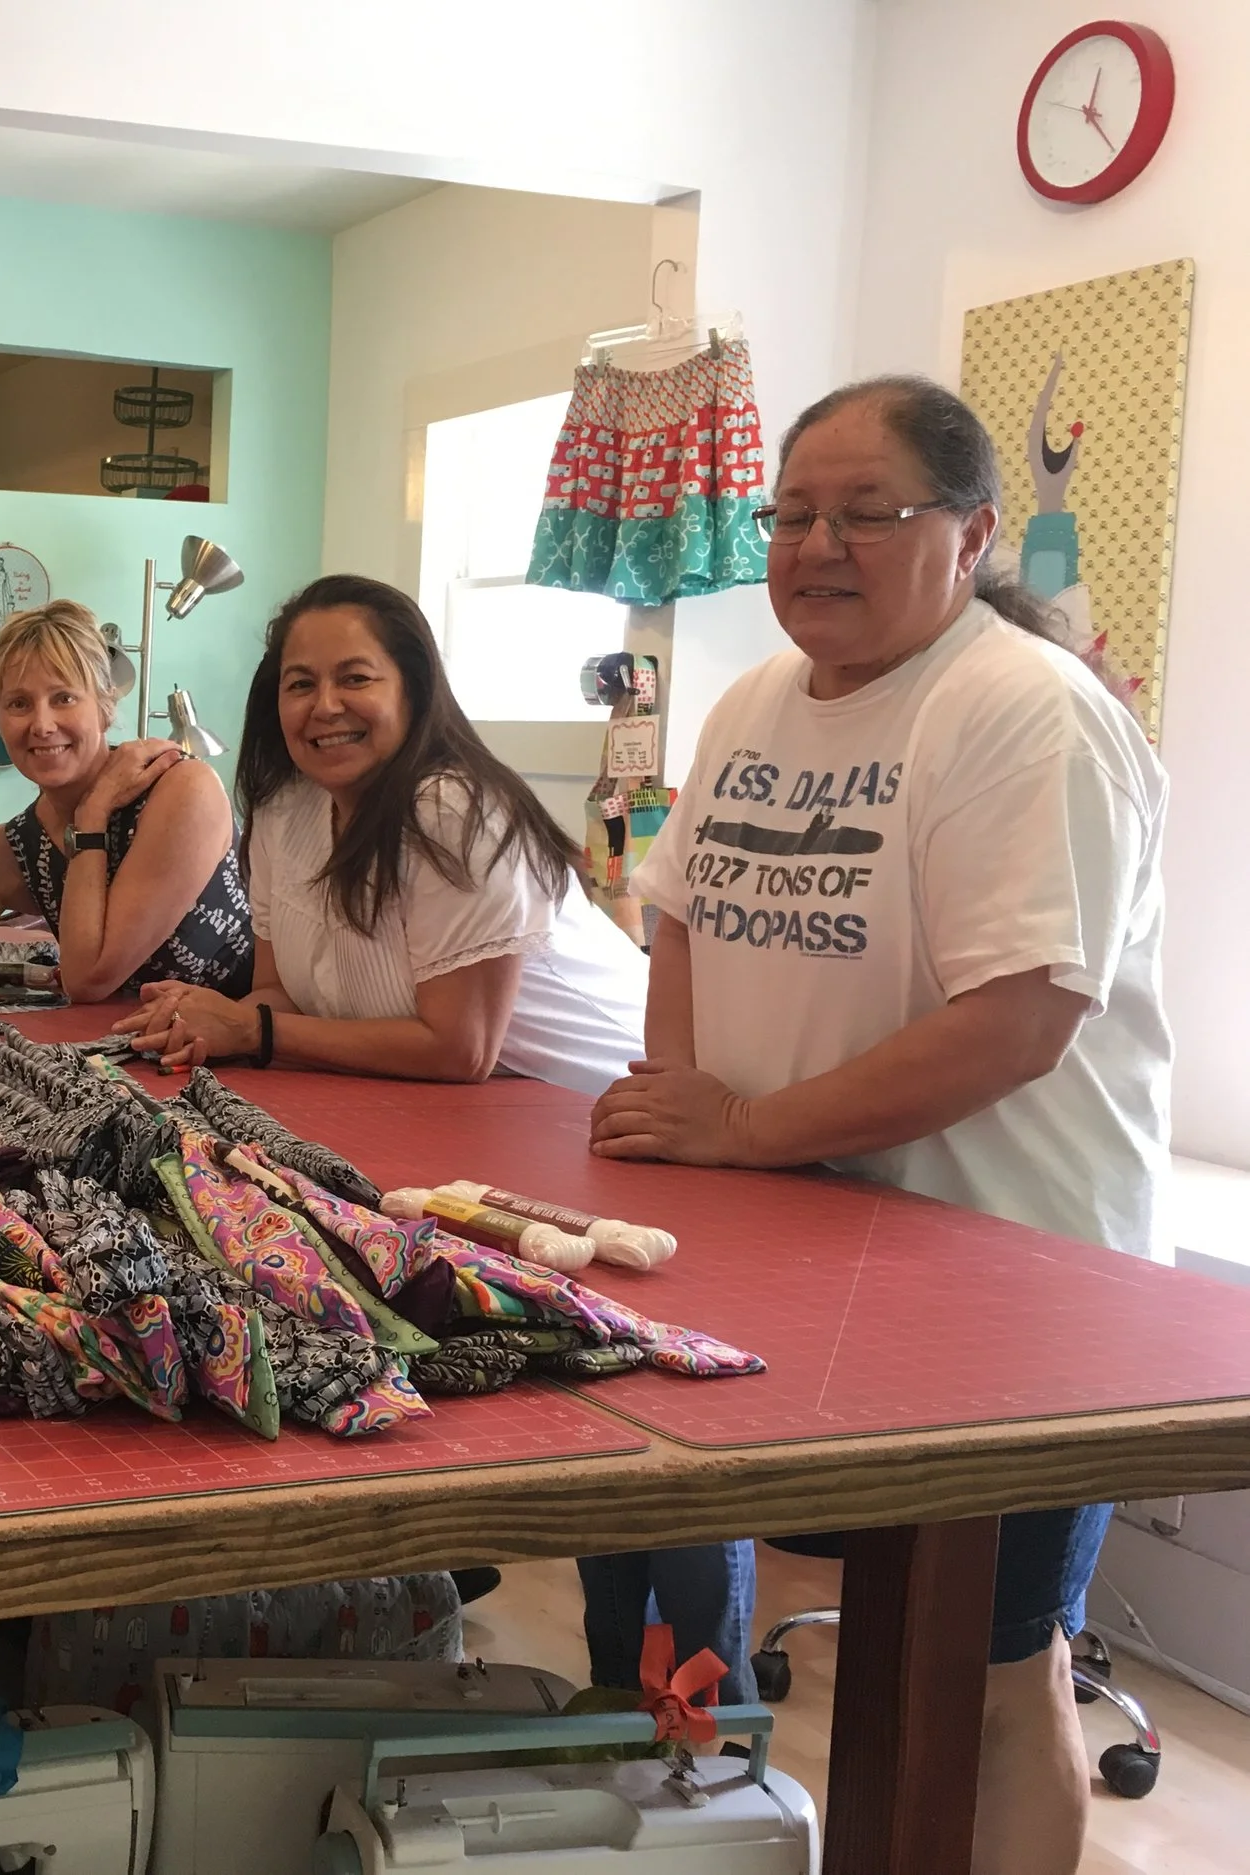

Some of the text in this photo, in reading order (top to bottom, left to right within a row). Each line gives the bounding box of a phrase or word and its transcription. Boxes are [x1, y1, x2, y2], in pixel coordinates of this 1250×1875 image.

[742, 750, 762, 760] 700
[784, 761, 904, 812] DALAS
[755, 864, 817, 897] TONS
[818, 865, 873, 899] OF
[510, 1199, 592, 1228] BRAIDED NYLON ROPE
